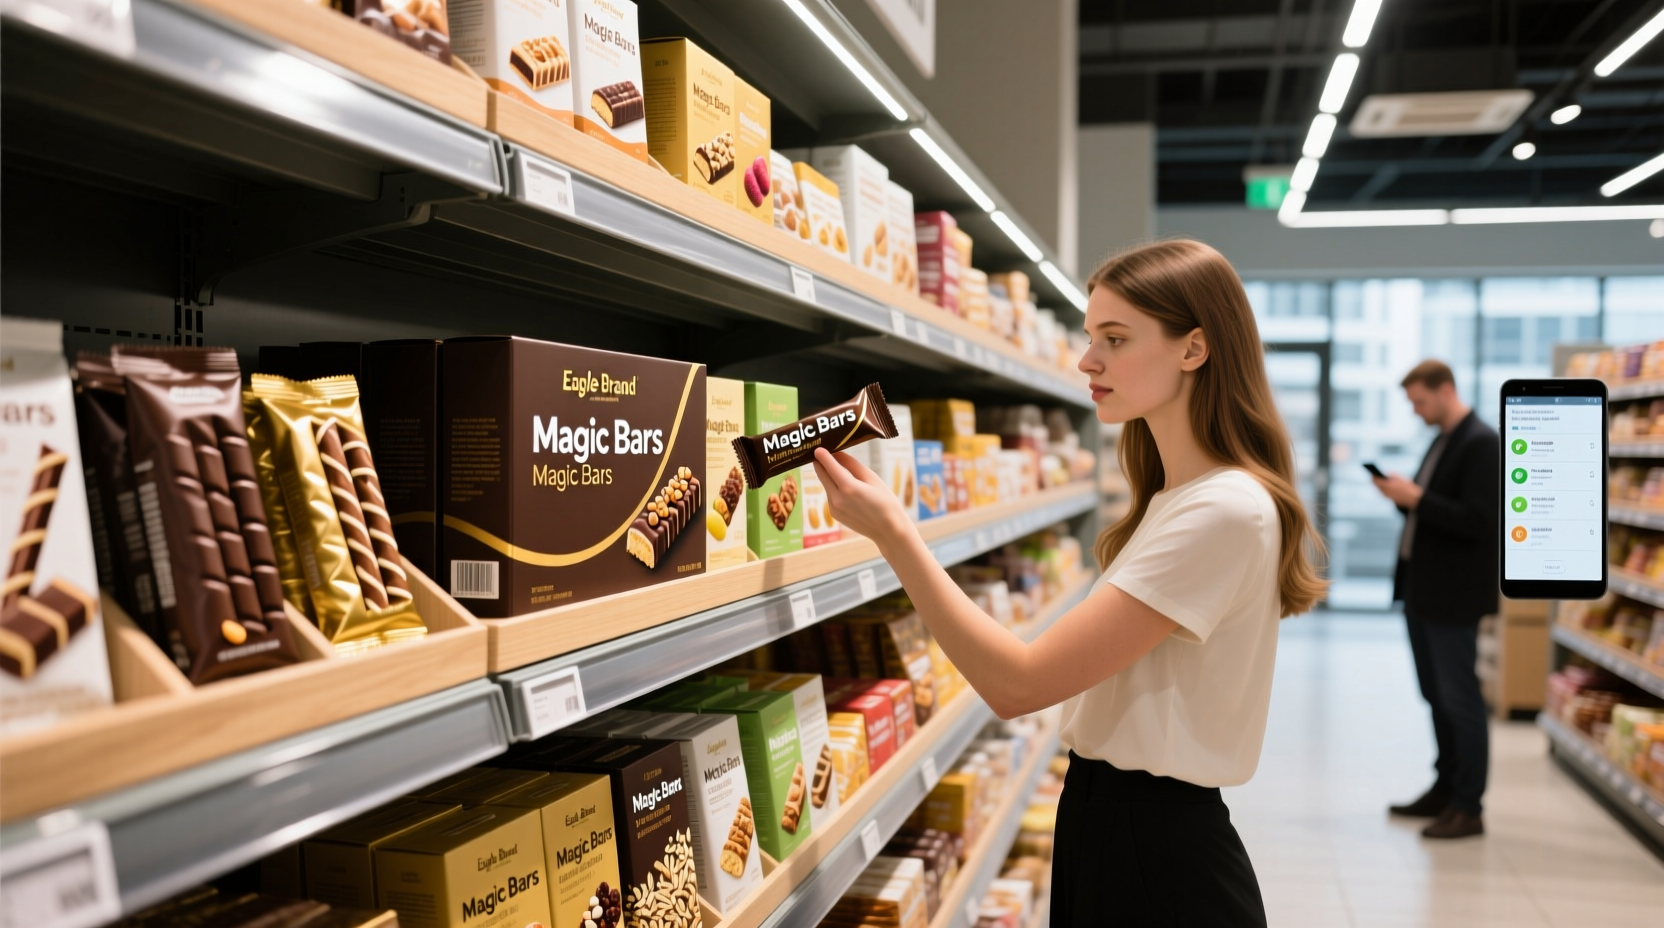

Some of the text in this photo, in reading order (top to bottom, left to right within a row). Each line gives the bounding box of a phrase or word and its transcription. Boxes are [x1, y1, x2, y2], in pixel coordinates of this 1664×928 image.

[562, 369, 637, 398] Eagle Brand
[532, 415, 609, 463] Magic
[614, 419, 664, 455] Bars
[763, 422, 816, 454] Magic
[816, 409, 856, 434] Bars
[532, 464, 613, 492] Magic Bars
[556, 827, 613, 869] Magic Bars
[462, 884, 507, 923] Magic
[507, 869, 540, 899] Bars
